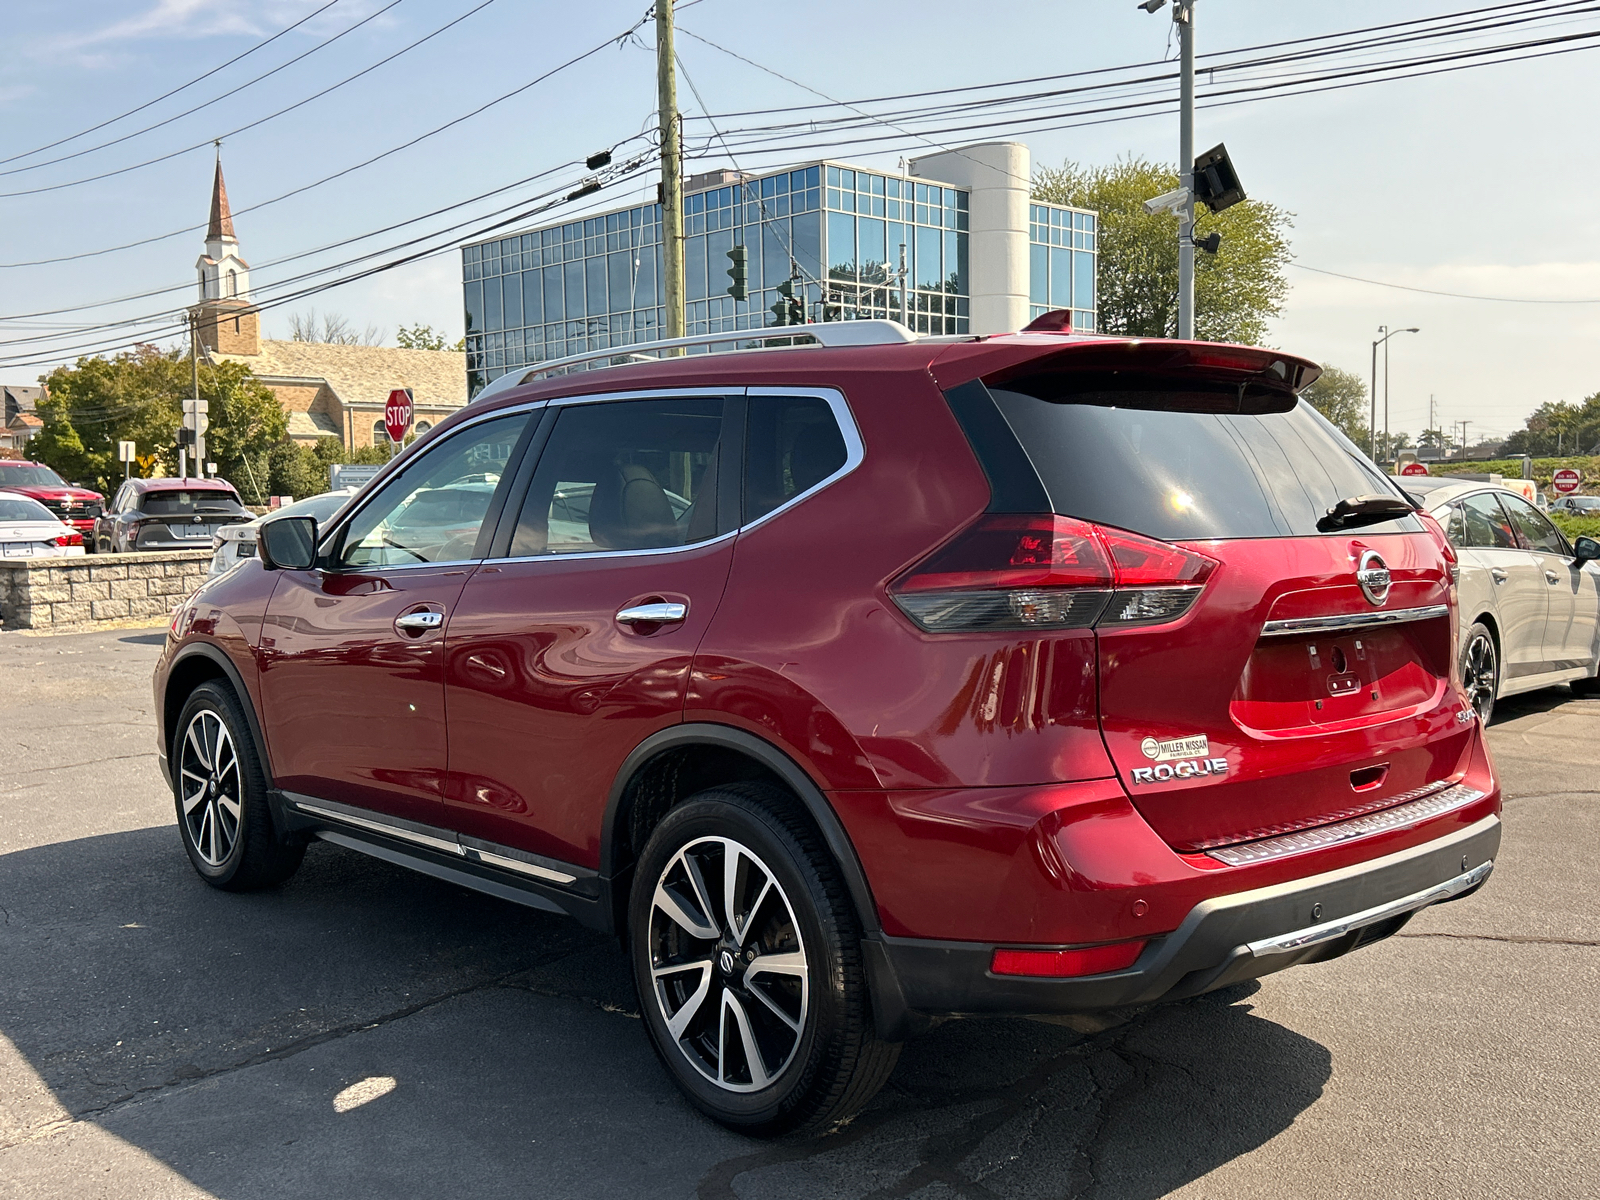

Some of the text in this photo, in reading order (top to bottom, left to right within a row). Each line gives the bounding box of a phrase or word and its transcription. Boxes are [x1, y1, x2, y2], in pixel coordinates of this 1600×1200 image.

[387, 406, 411, 427] STOP
[1160, 742, 1185, 754] MILLER
[1185, 740, 1208, 752] NISSAN
[1131, 758, 1230, 784] ROGUE
